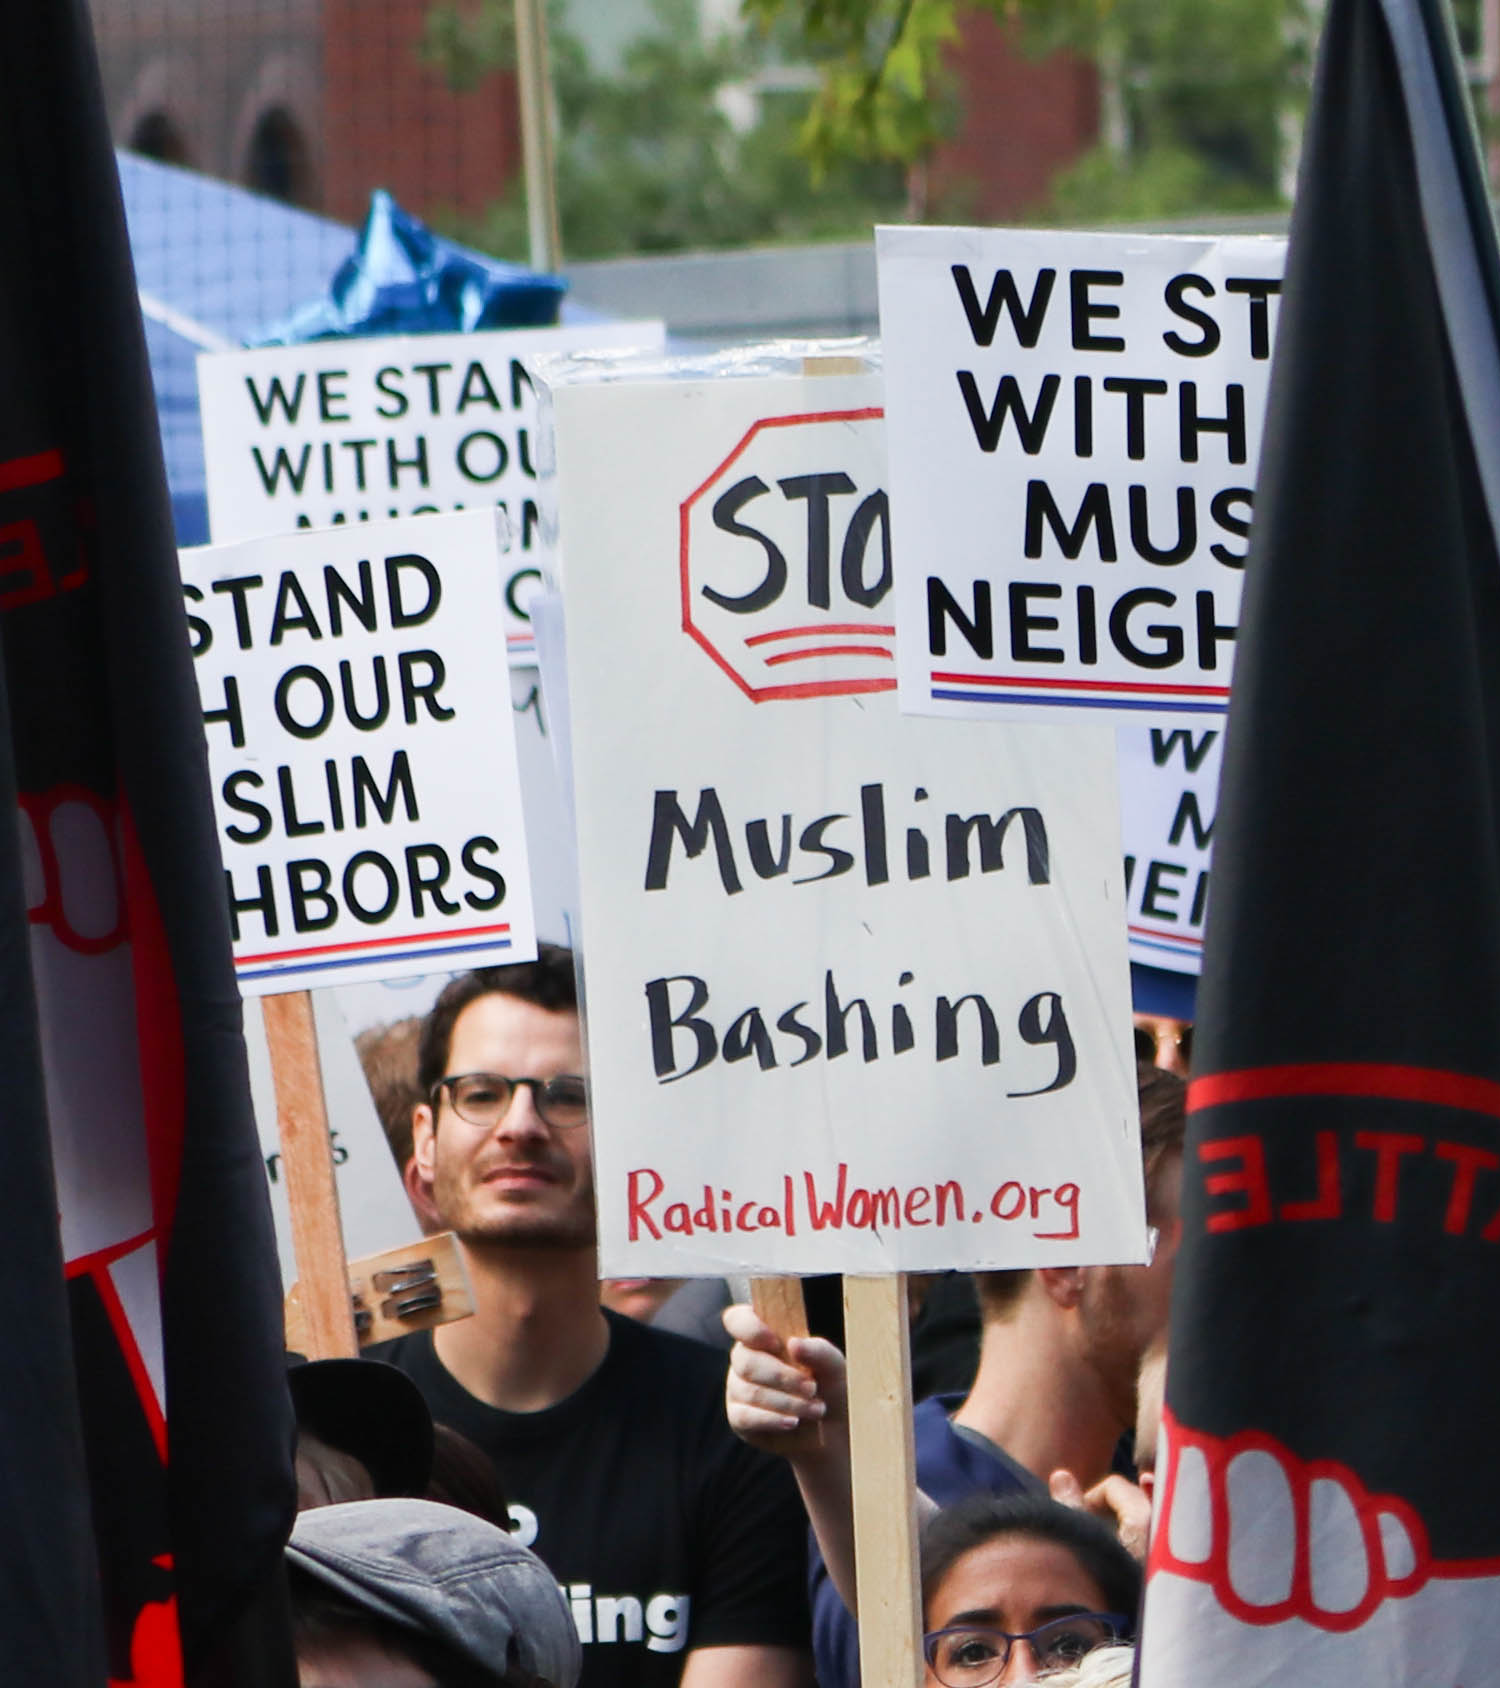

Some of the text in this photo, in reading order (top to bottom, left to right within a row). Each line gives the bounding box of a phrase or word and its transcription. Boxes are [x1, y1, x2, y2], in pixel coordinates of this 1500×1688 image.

[951, 264, 1126, 353] WE
[245, 370, 350, 426] WE
[956, 369, 1248, 464] WITH
[251, 435, 430, 497] WITH
[274, 649, 456, 742] OUR
[644, 783, 1050, 895] Muslim
[644, 969, 1077, 1098] Bashing
[627, 1164, 1081, 1244] RadicalWomen.org
[558, 1583, 691, 1653] ing
